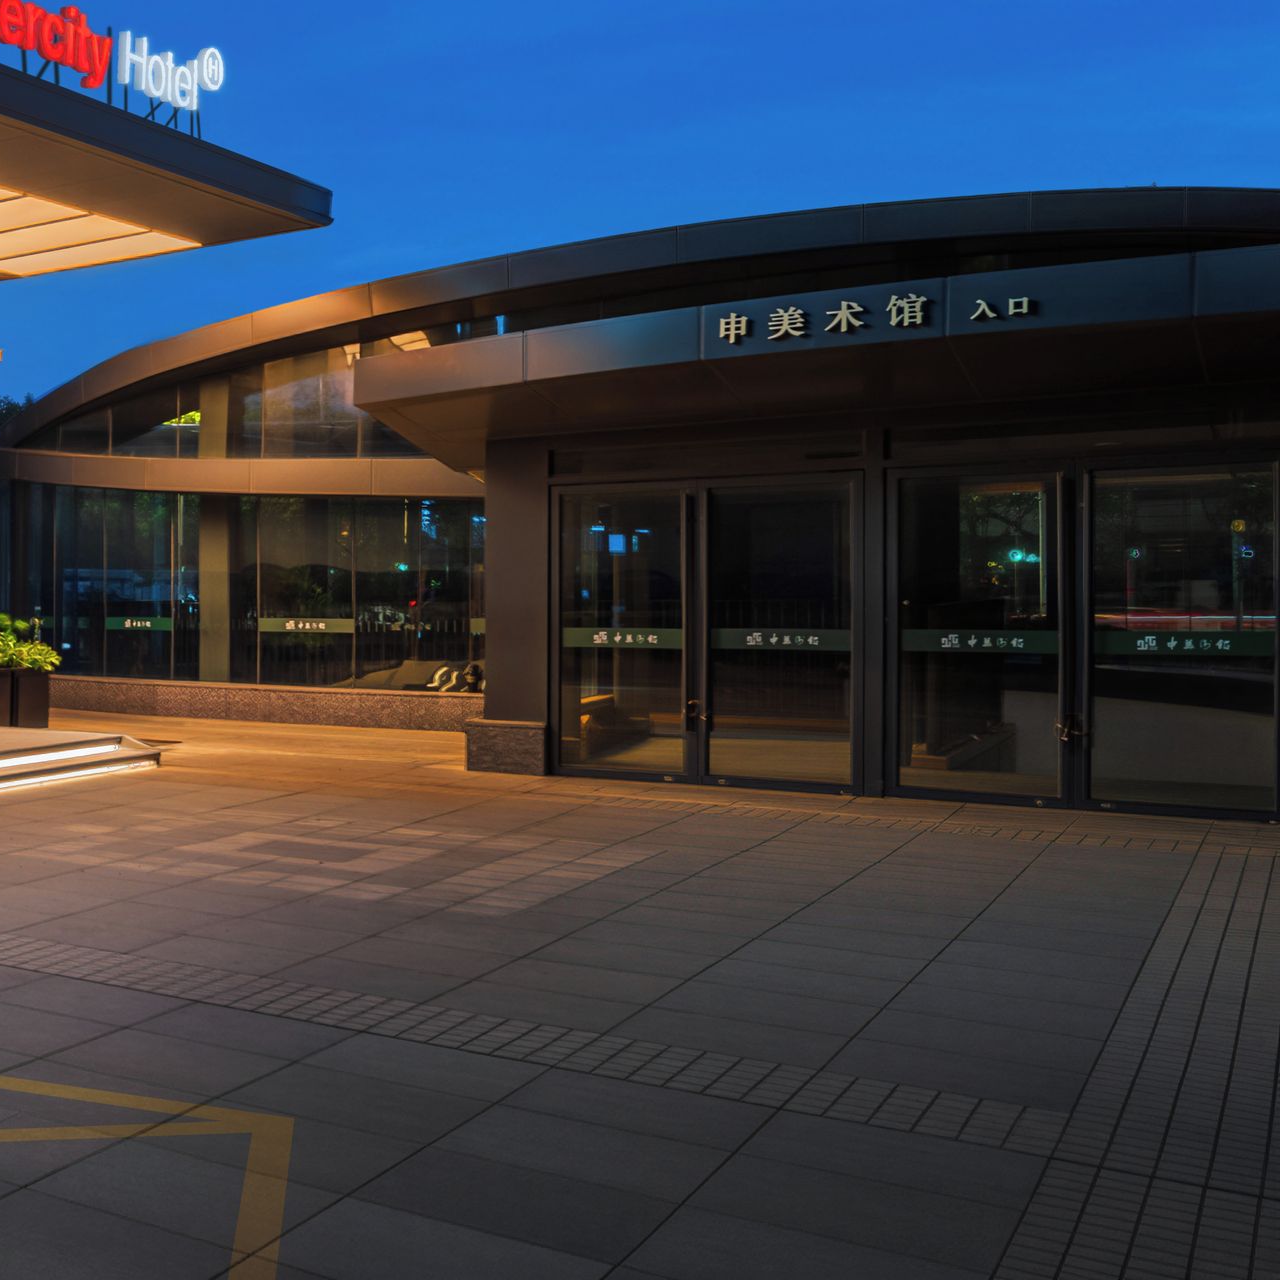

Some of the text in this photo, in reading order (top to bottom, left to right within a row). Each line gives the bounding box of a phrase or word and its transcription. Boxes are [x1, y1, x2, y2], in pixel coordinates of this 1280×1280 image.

[117, 30, 199, 111] Hotel
[718, 292, 1031, 345] 申美术馆 入口
